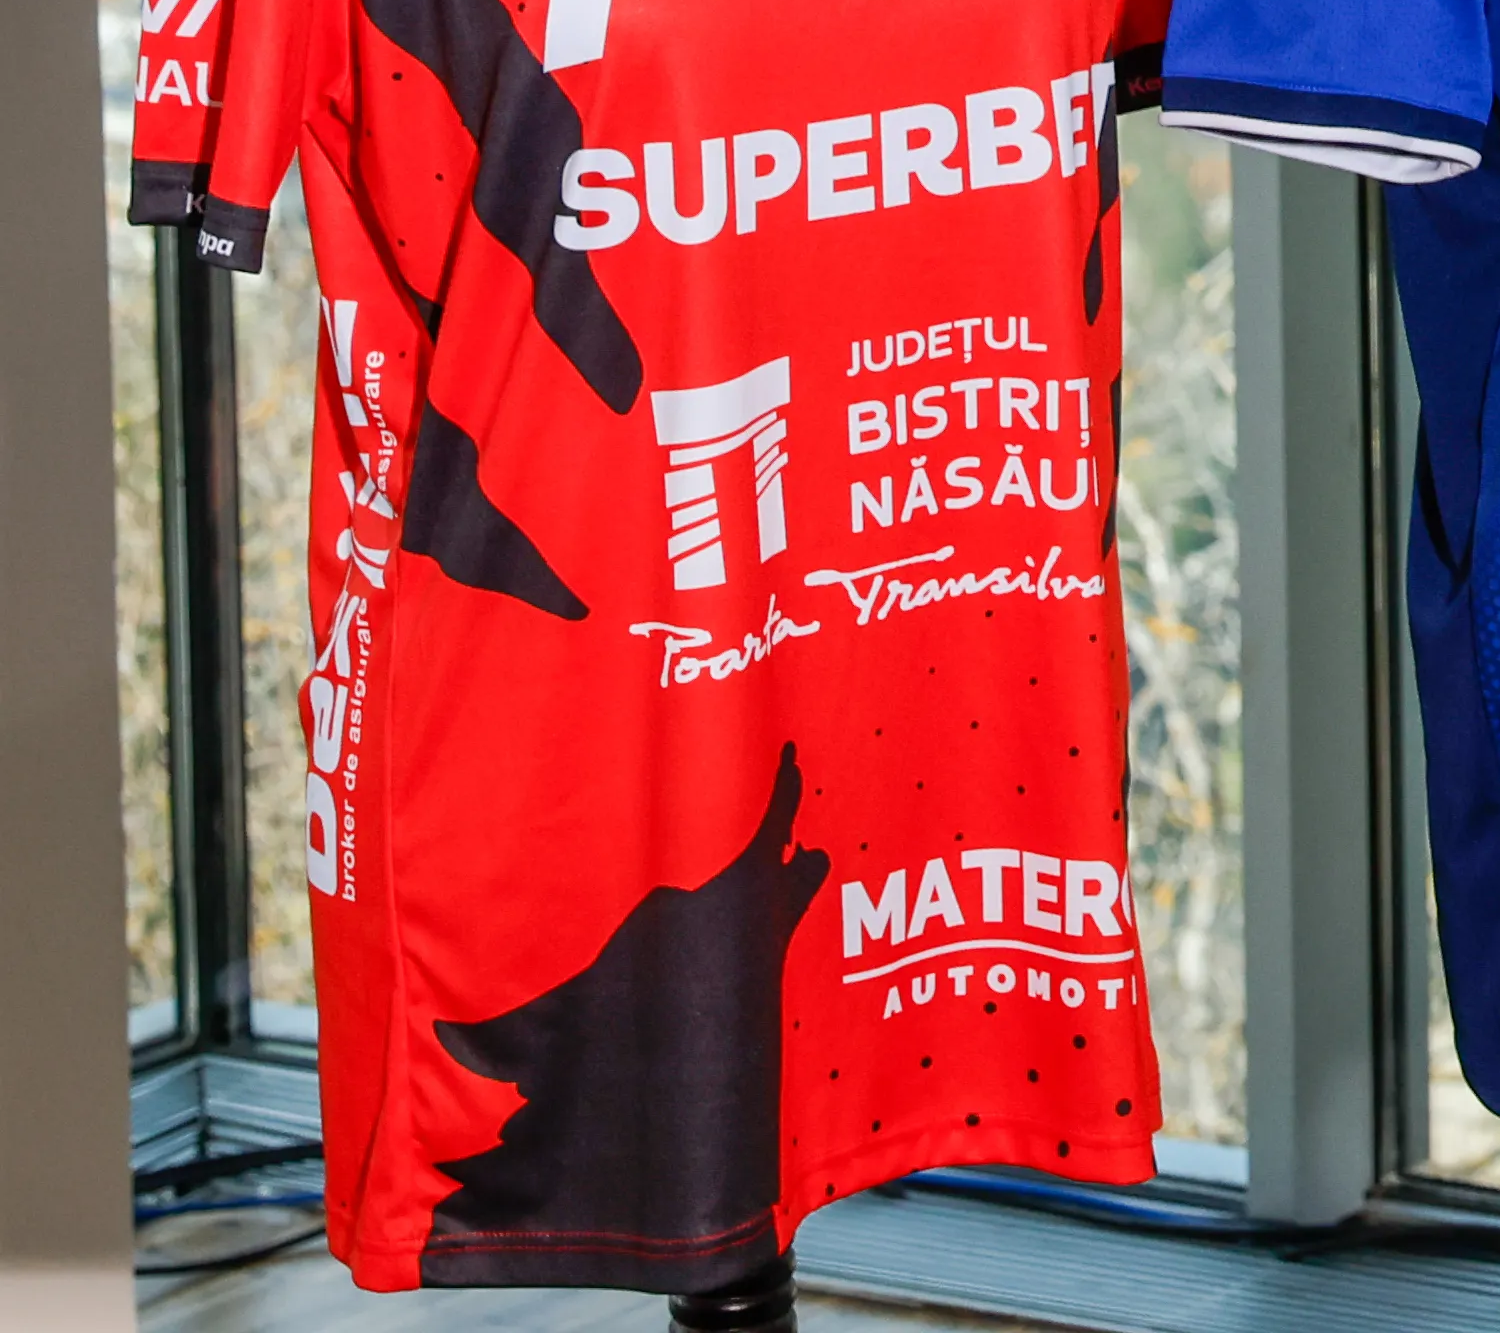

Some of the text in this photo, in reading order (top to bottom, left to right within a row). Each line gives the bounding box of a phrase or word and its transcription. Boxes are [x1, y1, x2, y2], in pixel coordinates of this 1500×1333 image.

[846, 316, 1048, 377] JUDEȚUL
[365, 350, 398, 492] asigurare
[851, 443, 1099, 533] NĂSĂU
[629, 594, 820, 687] Poarta
[345, 752, 359, 791] de
[342, 798, 356, 902] broker
[841, 848, 1133, 959] MATER
